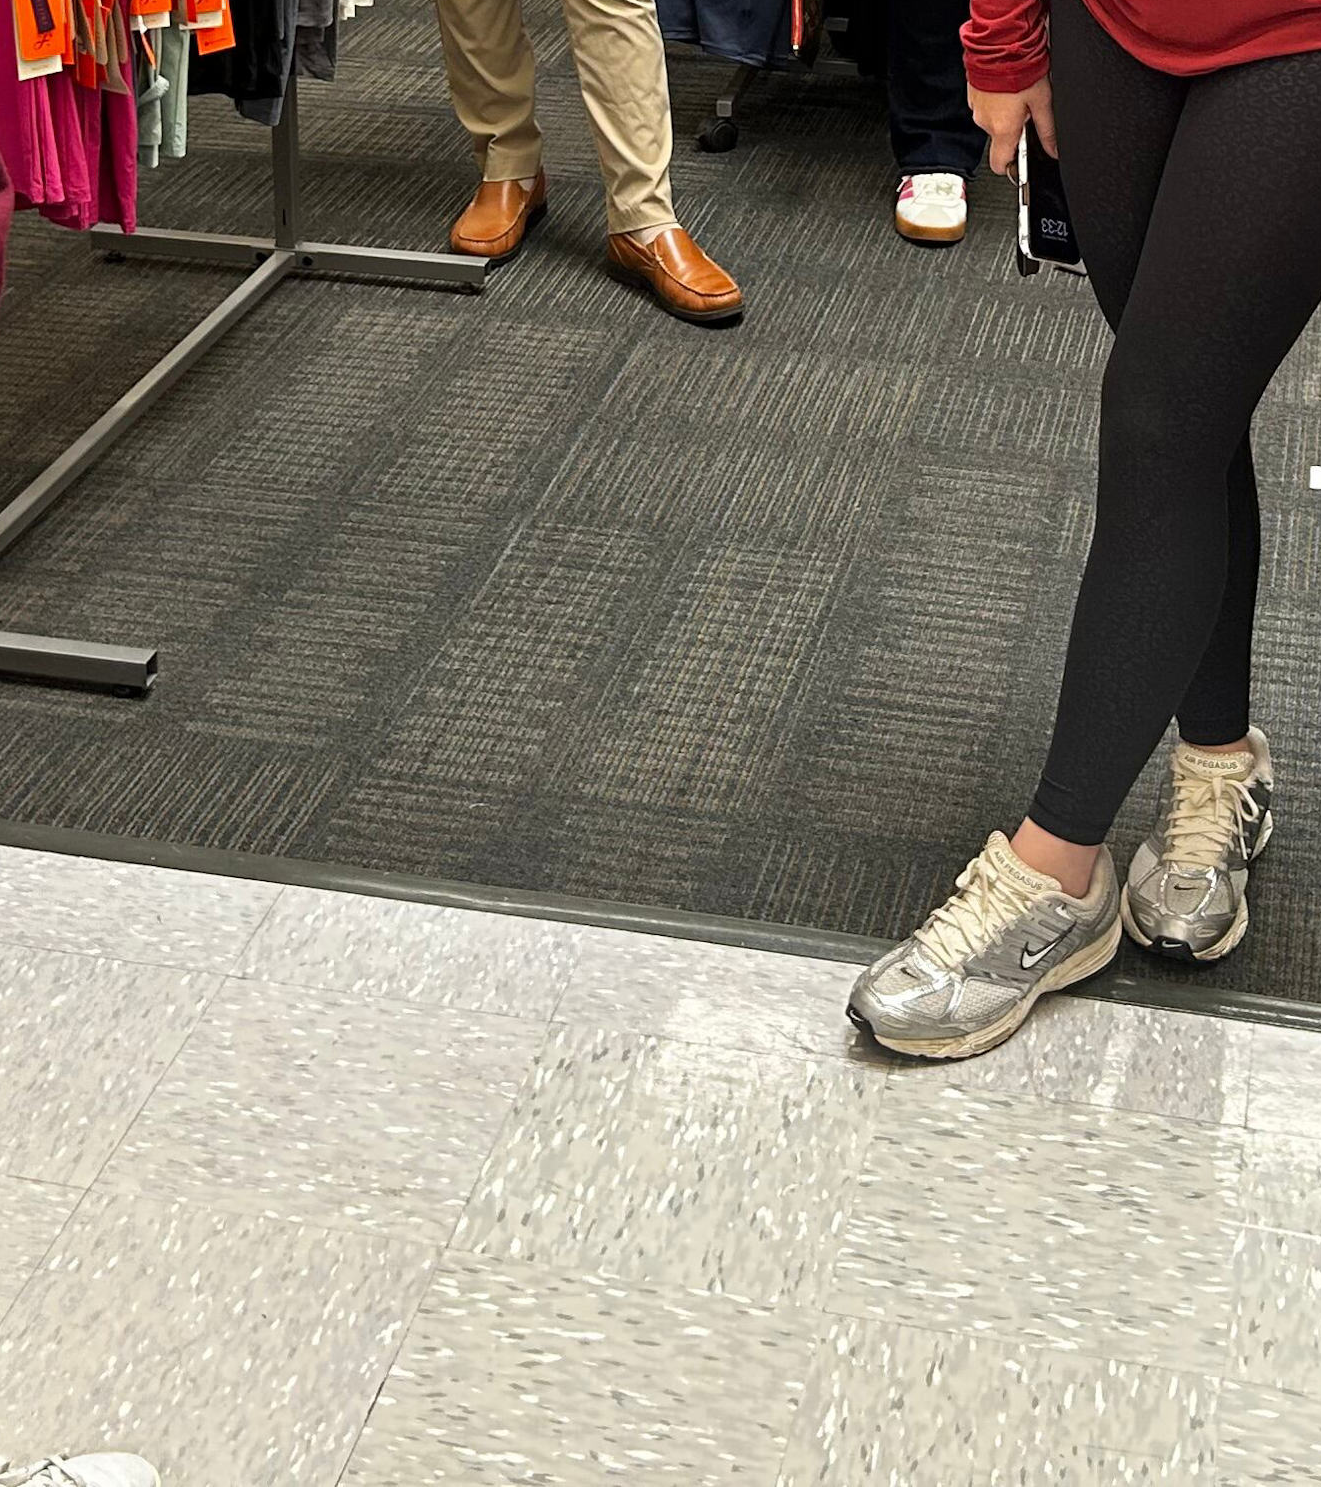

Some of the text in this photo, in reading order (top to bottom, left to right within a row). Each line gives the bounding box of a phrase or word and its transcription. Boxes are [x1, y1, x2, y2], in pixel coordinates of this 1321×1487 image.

[1040, 217, 1069, 237] 12:33
[1197, 759, 1238, 770] PEGASUS
[1004, 863, 1043, 891] PEGASUS
